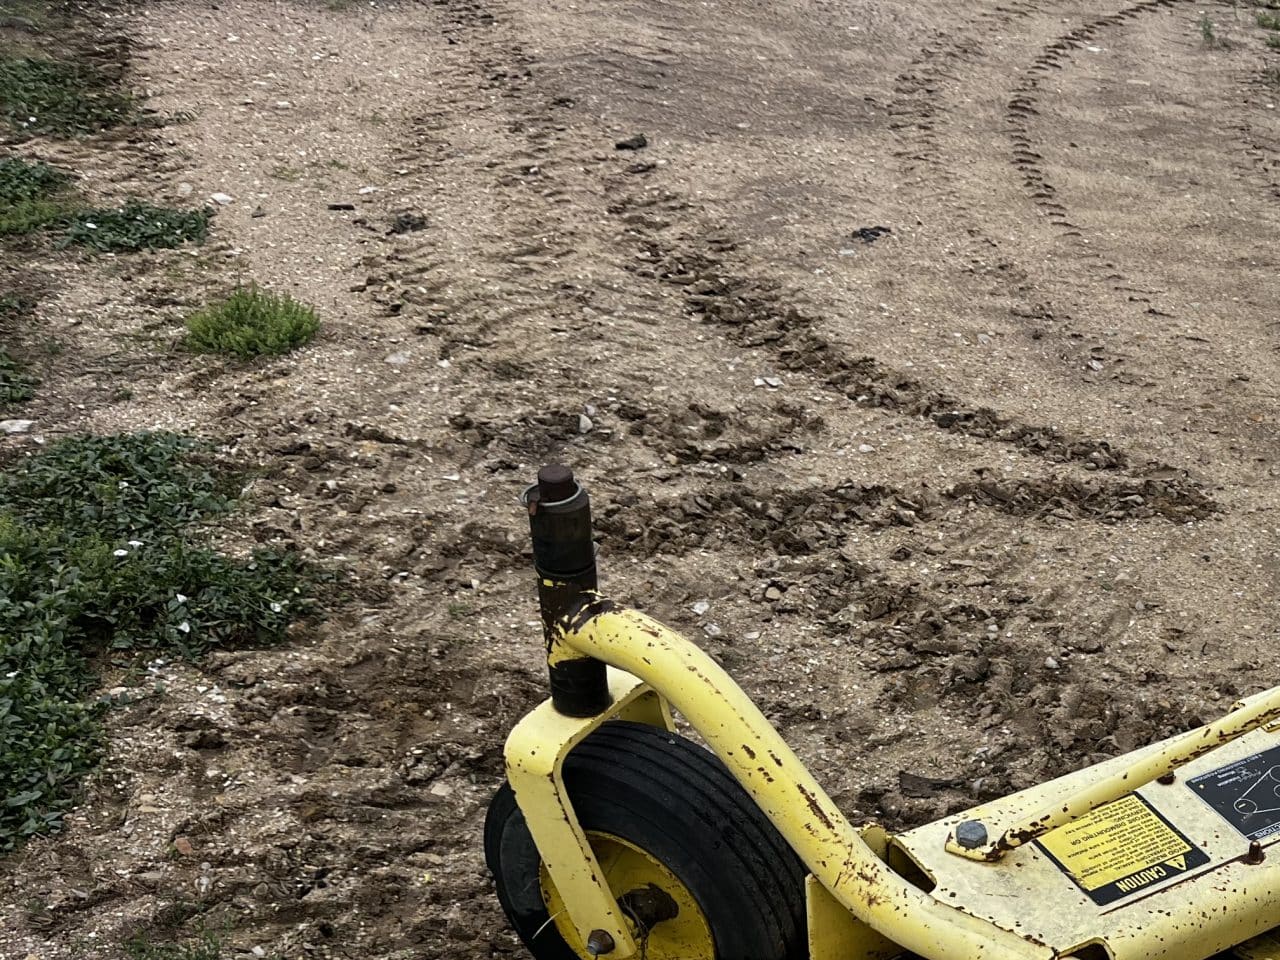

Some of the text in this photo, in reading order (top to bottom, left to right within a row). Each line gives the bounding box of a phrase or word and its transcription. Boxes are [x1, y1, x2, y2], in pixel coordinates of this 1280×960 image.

[1143, 844, 1187, 864] AVOID INJURY
[1114, 864, 1168, 892] CAUTION
